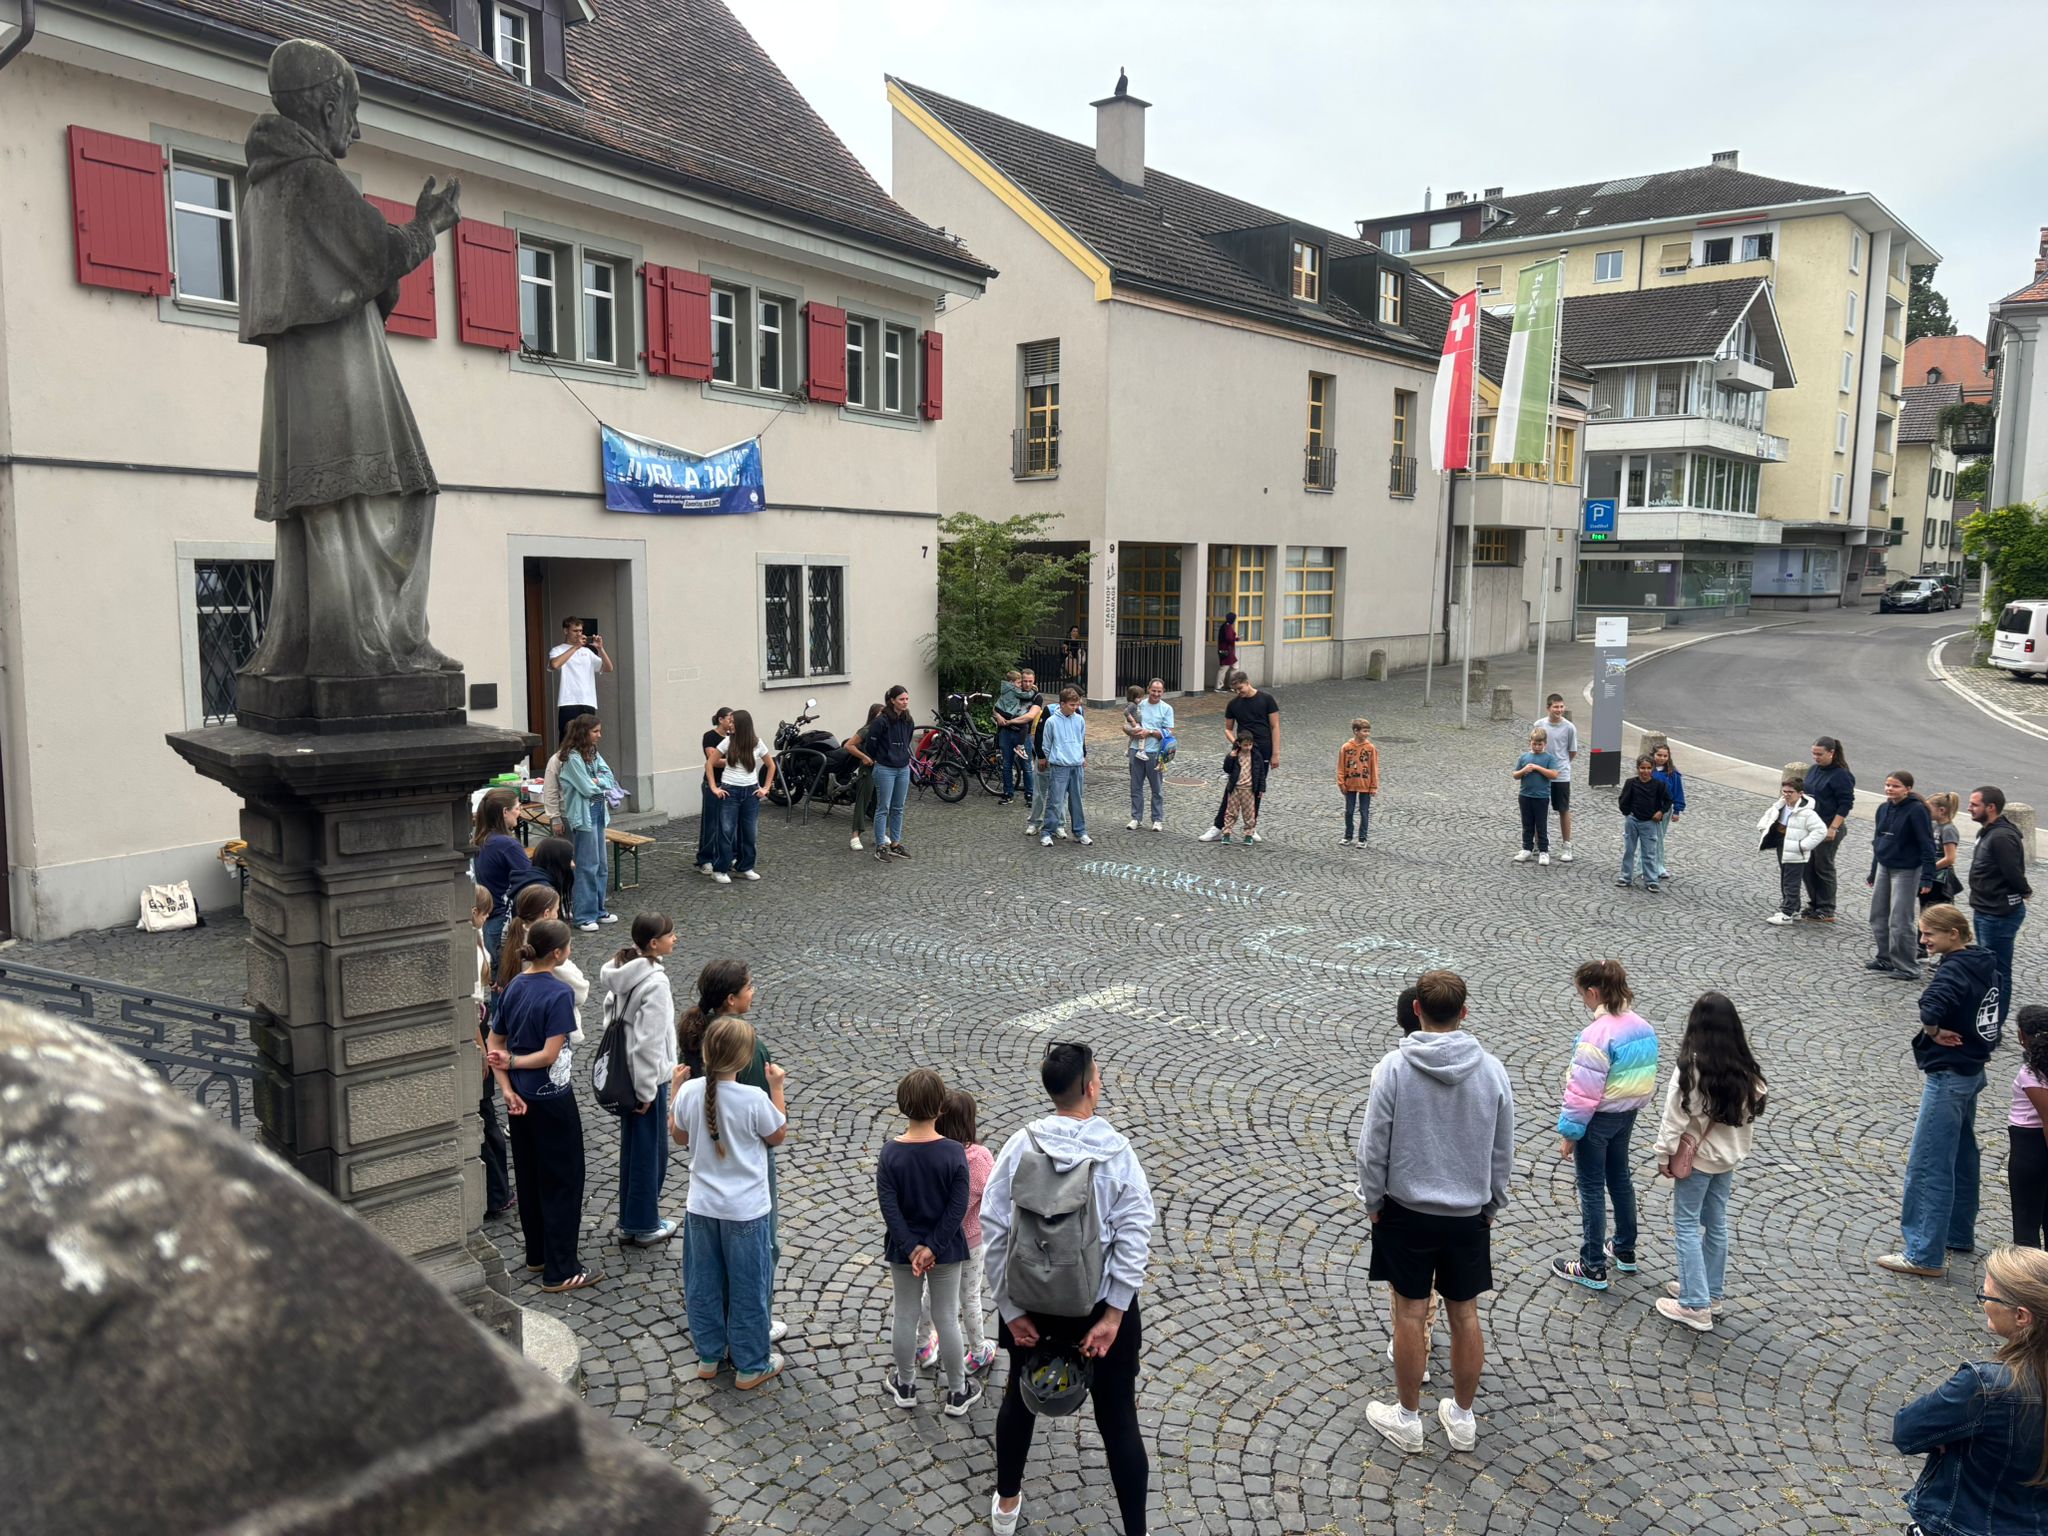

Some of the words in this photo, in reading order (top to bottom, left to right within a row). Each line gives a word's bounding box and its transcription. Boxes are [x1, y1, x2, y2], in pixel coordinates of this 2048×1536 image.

[1593, 507, 1604, 521] P
[922, 546, 928, 559] 7
[1110, 544, 1115, 554] 9
